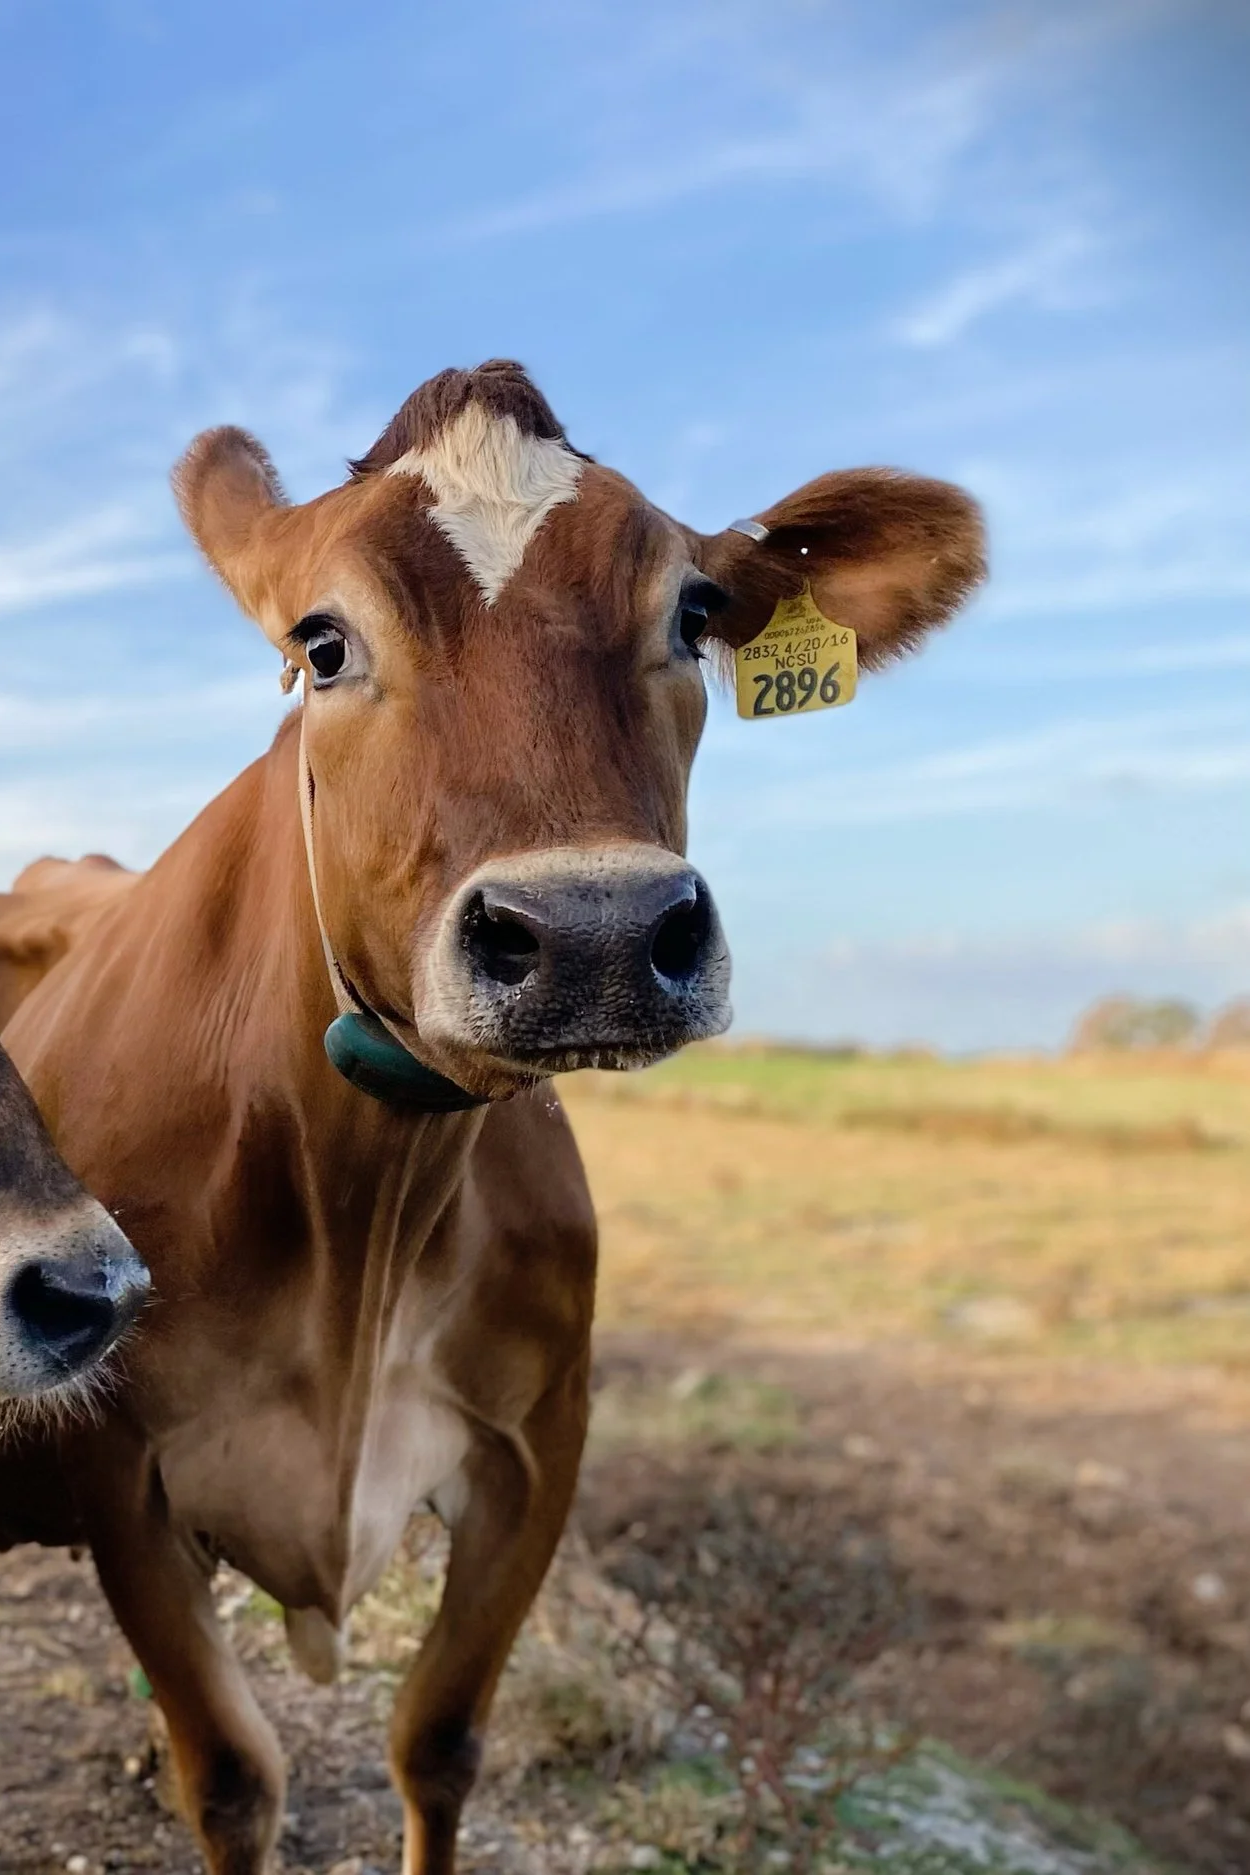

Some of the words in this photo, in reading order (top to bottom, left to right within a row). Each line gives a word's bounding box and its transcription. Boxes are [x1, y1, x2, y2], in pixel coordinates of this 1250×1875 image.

[743, 643, 779, 661] 2832
[784, 631, 848, 654] 4/20/16
[775, 652, 817, 670] NCSU
[752, 662, 840, 716] 2896
